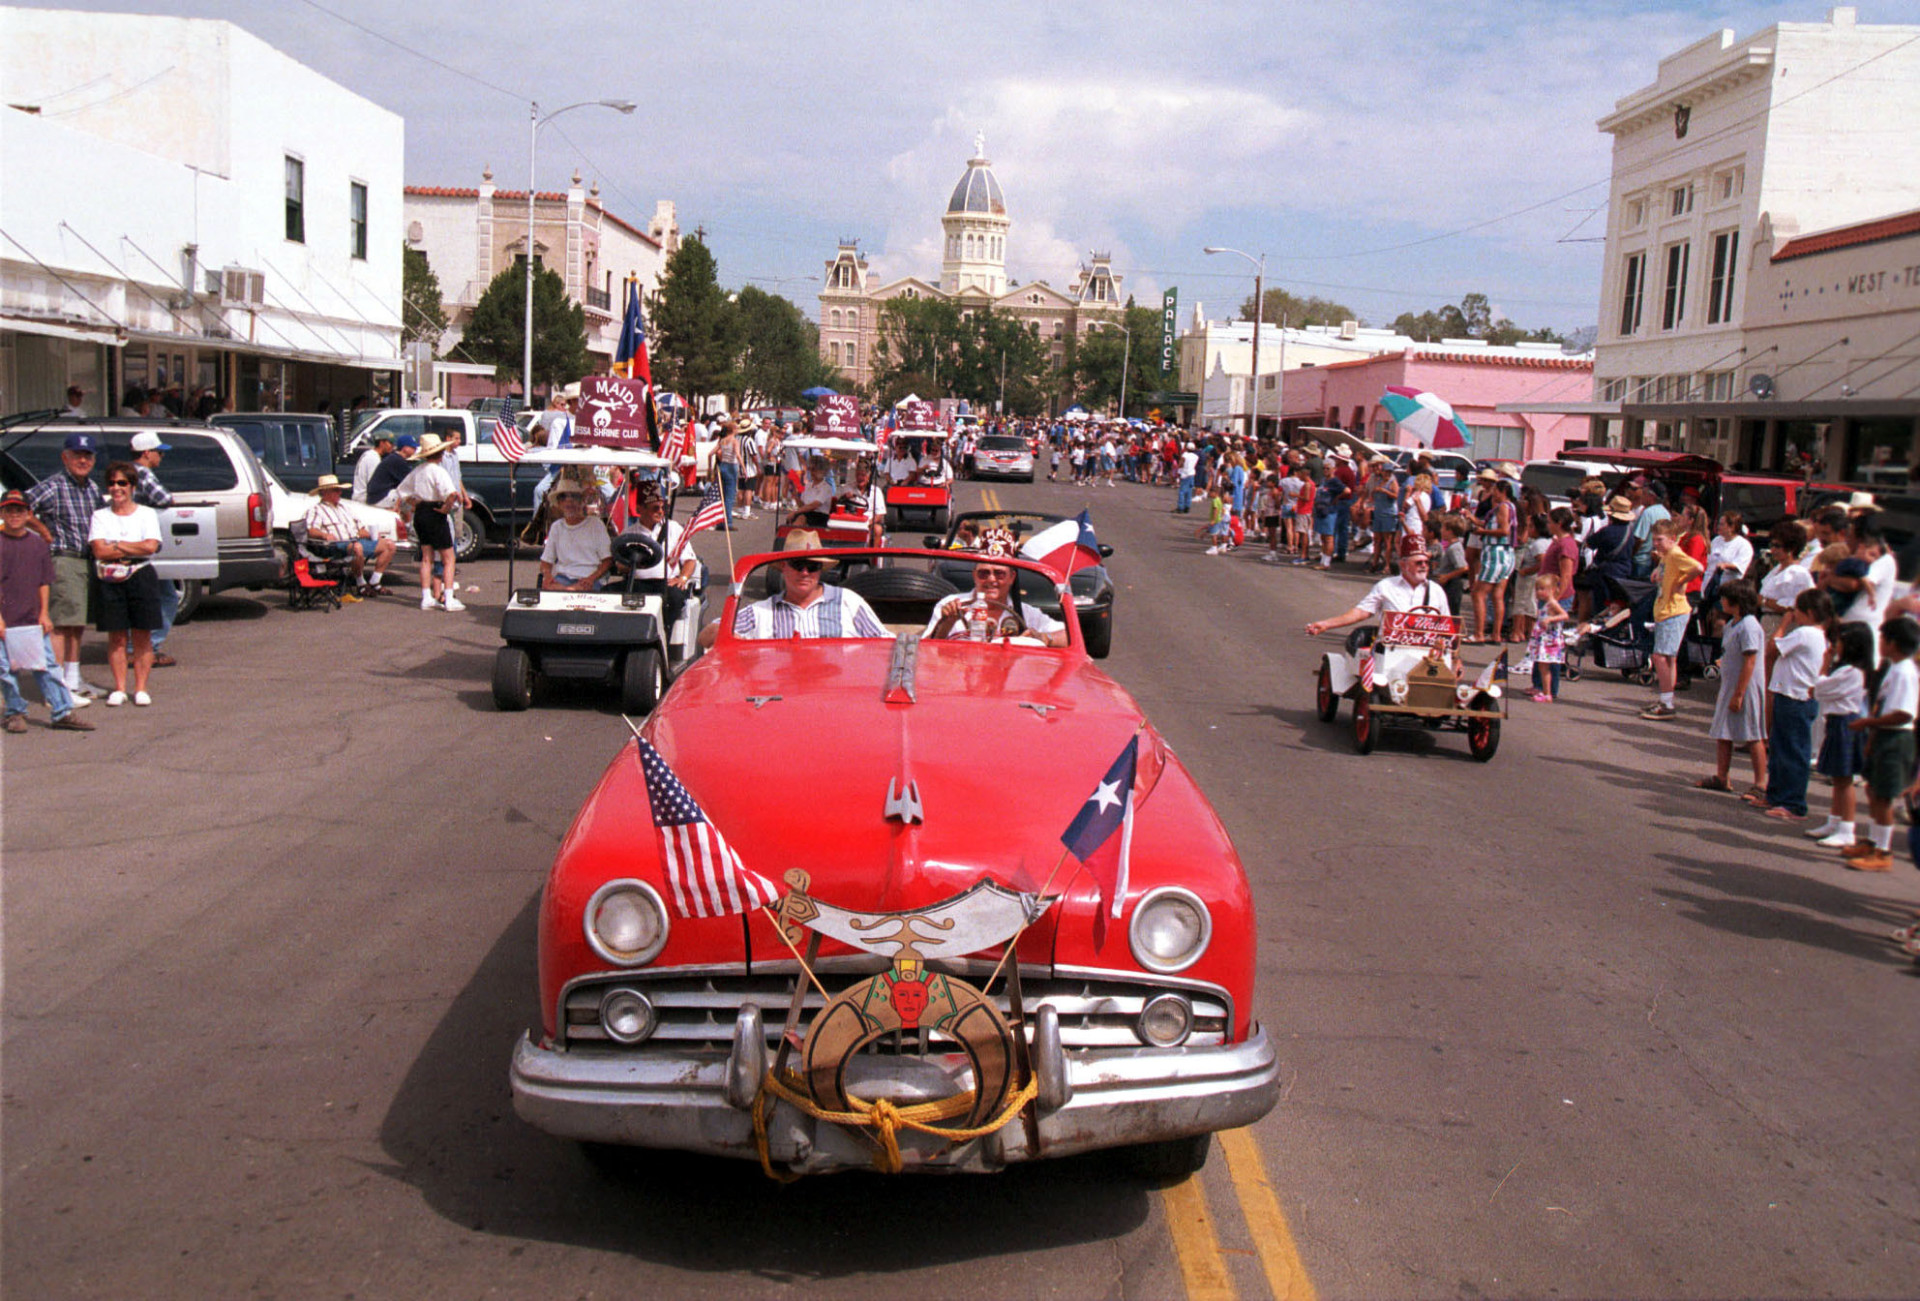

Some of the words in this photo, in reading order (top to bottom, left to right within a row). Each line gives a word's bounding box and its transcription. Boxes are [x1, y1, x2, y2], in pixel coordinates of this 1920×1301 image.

[1848, 271, 1886, 294] WEST
[1163, 296, 1175, 370] PALACE
[596, 380, 639, 418] MAIDA
[829, 395, 856, 419] MAIDA
[594, 427, 619, 438] SHRINE
[622, 429, 639, 438] CLUB
[1415, 615, 1451, 631] Maida
